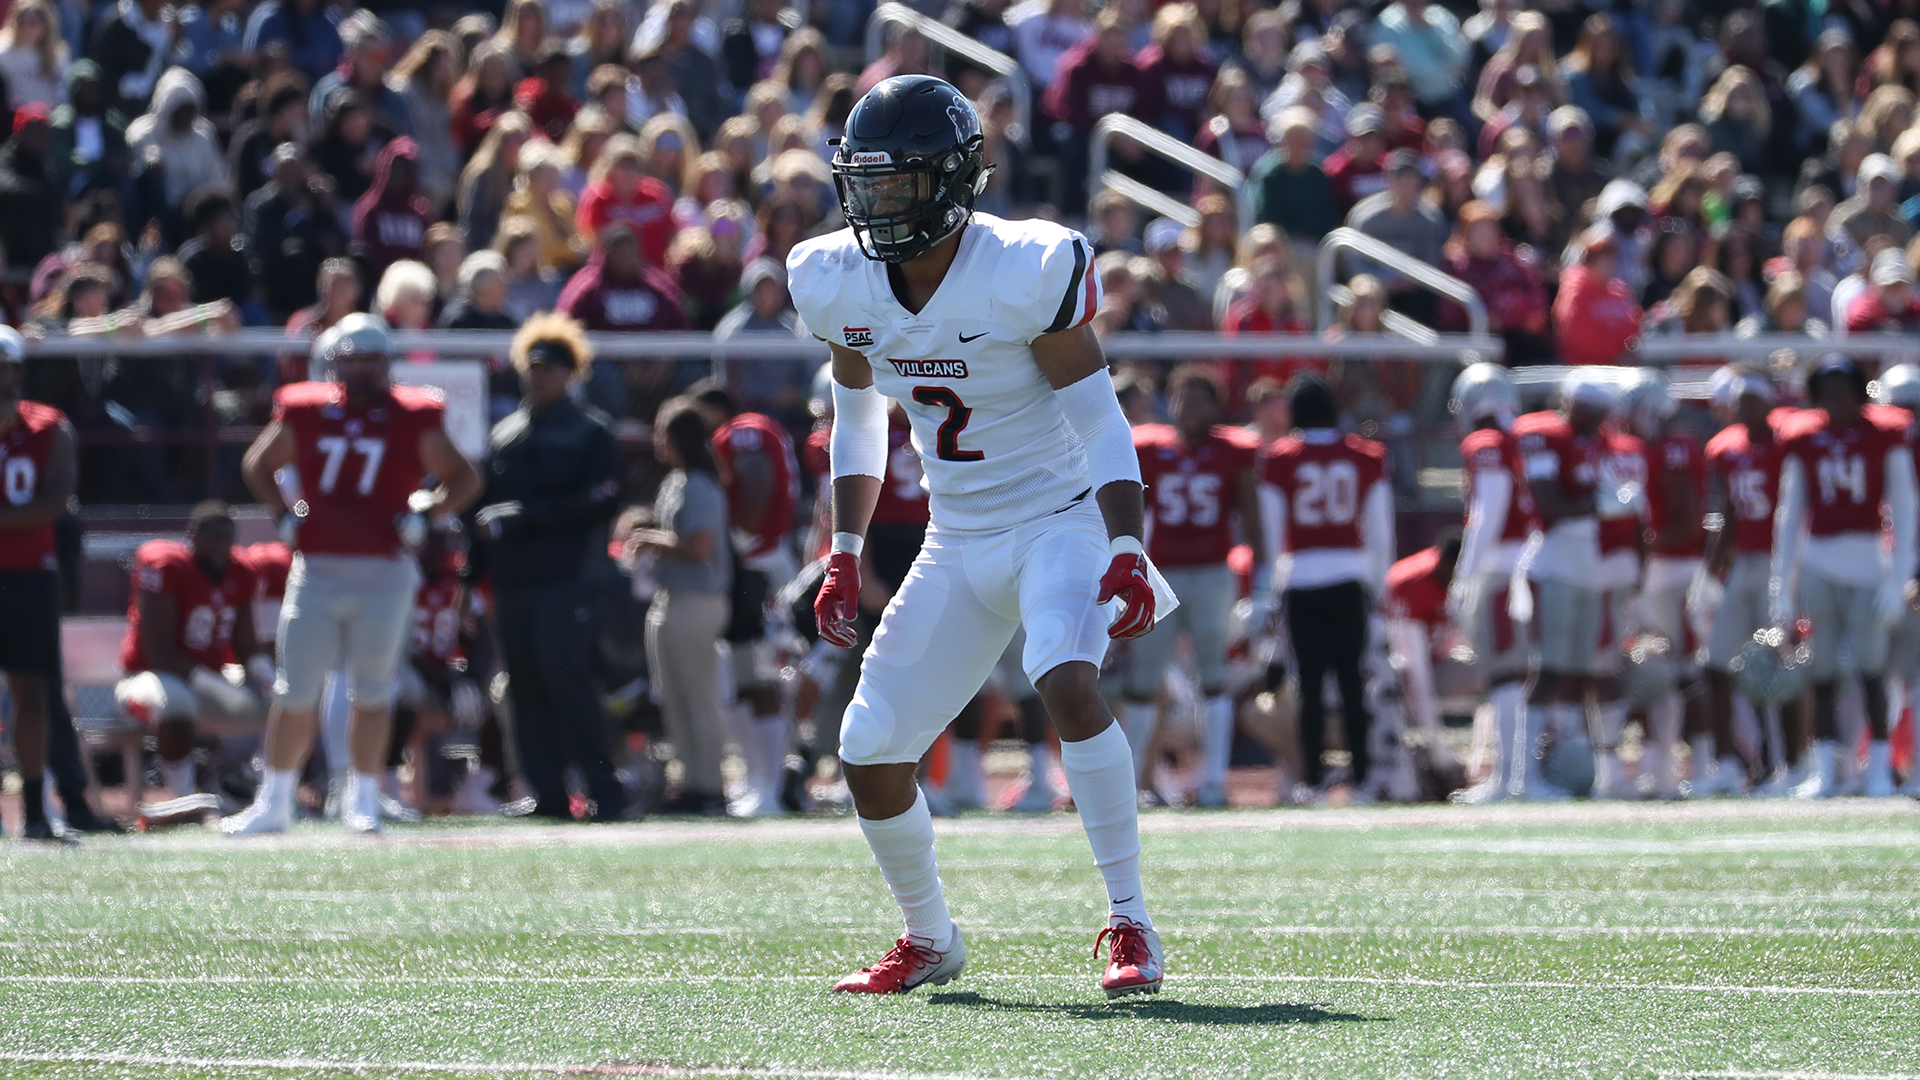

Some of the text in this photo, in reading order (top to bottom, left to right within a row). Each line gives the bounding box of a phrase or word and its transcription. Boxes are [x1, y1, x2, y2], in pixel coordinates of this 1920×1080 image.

[854, 154, 885, 163] Riddell
[844, 332, 873, 342] PSAC
[892, 360, 967, 377] VULCANS
[912, 386, 986, 462] 2
[317, 437, 386, 495] 77
[1816, 453, 1867, 504] 14
[1156, 472, 1222, 526] 55
[1293, 460, 1359, 525] 20
[1728, 469, 1771, 521] 15
